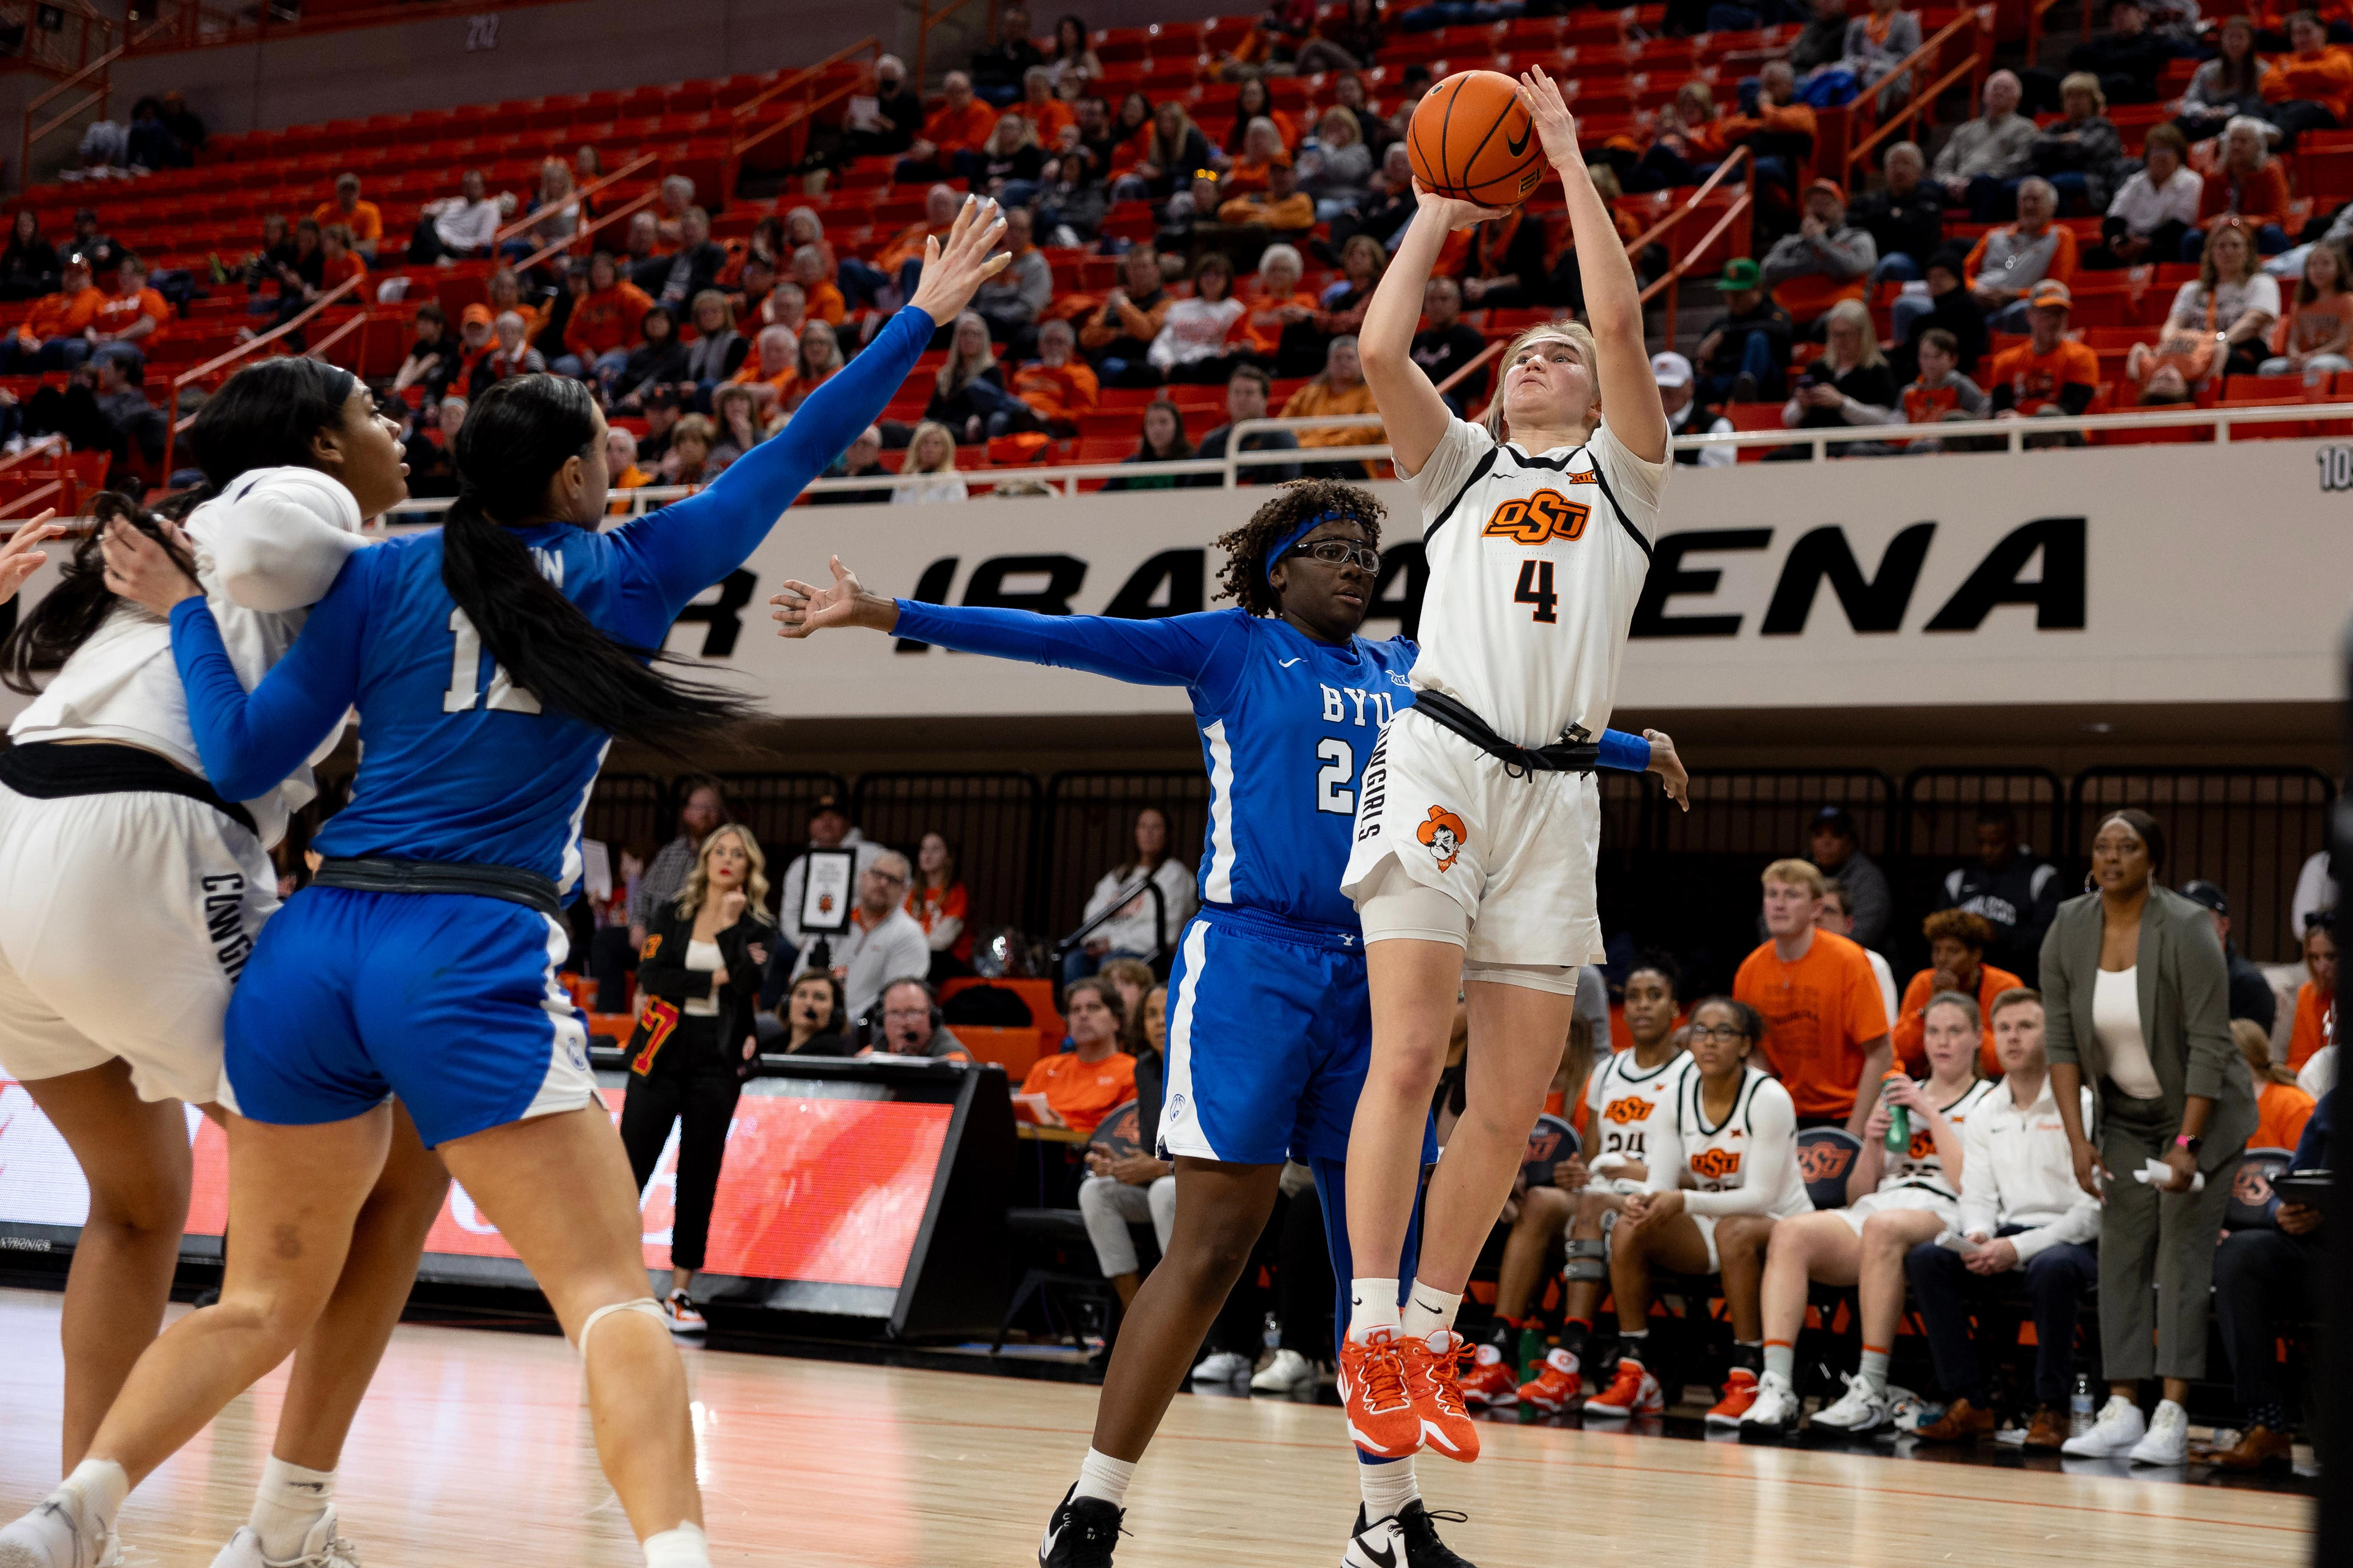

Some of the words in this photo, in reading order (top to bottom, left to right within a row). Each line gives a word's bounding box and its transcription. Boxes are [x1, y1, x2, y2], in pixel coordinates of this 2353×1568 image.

[2316, 445, 2353, 493] 10
[1481, 488, 1592, 546] OSU
[1355, 516, 2087, 641] AENA
[1513, 560, 1558, 624] 4
[1319, 682, 1394, 731] BYU
[1315, 735, 1374, 817] 2
[201, 872, 253, 984] COWGI
[631, 994, 680, 1076] 7
[1604, 1094, 1656, 1126] OSU
[1691, 1147, 1741, 1179] OSU
